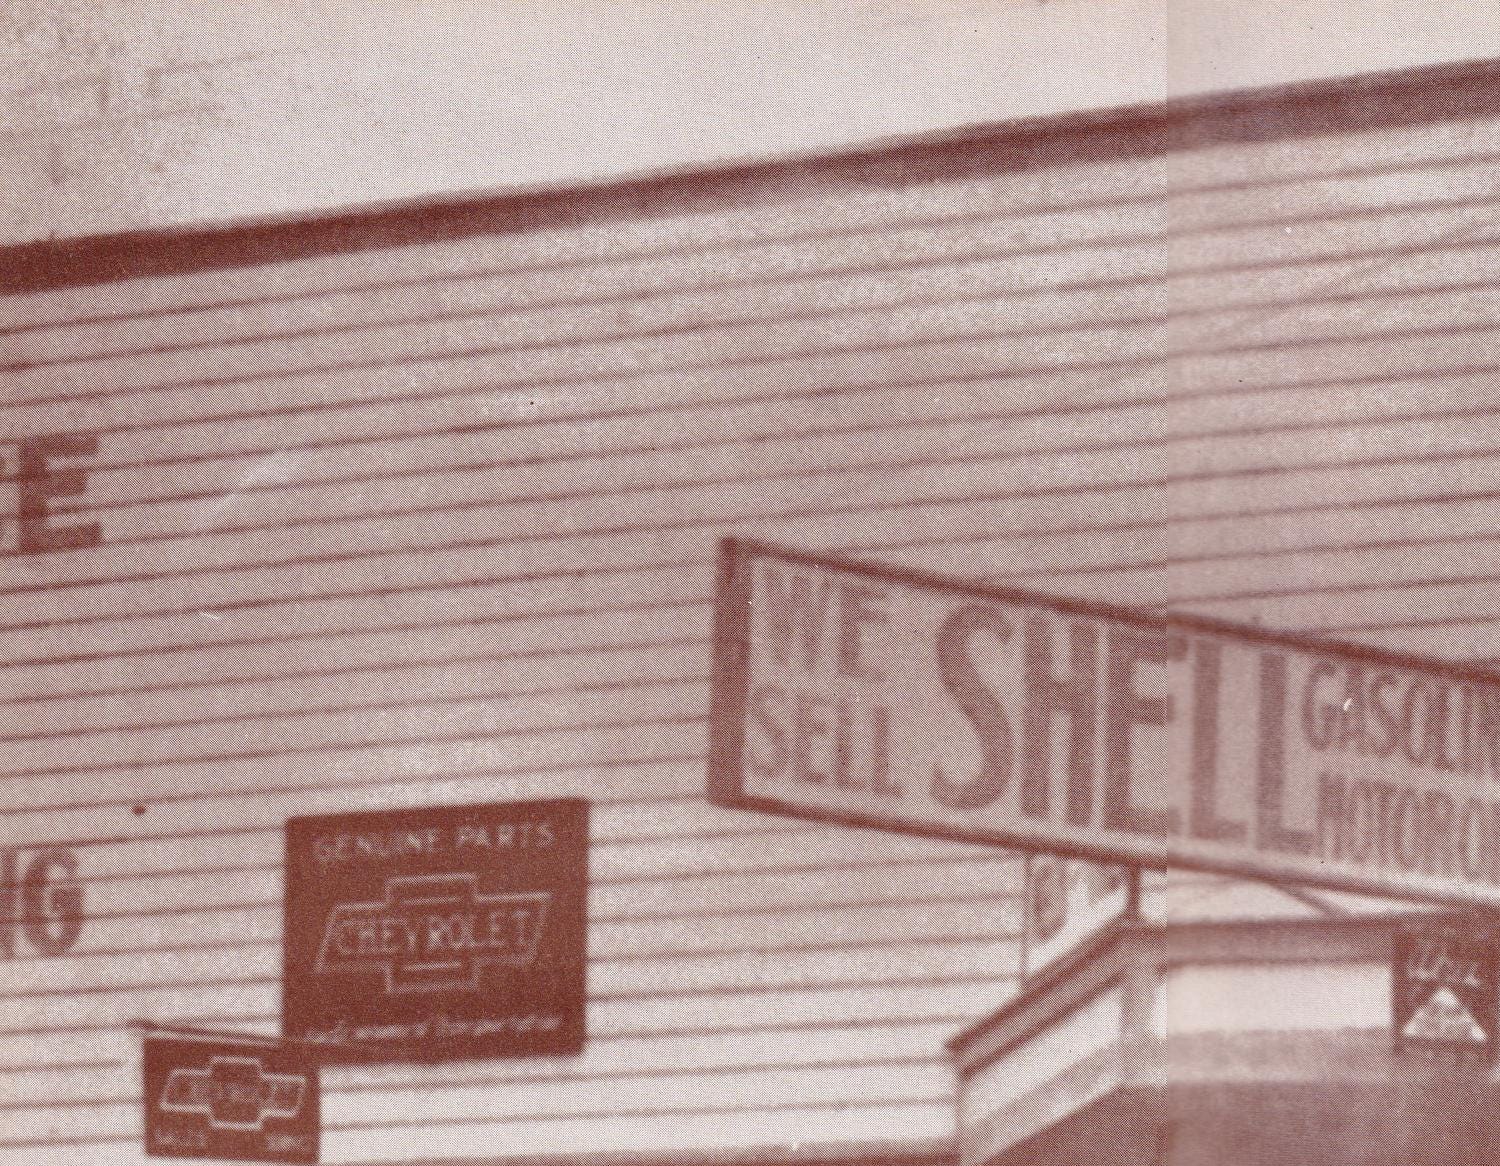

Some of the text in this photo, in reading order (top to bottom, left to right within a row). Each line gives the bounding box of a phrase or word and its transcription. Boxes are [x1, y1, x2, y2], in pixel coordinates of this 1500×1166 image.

[762, 562, 890, 684] WE
[748, 684, 906, 799] SELL
[929, 604, 1315, 858] SHELL
[312, 819, 556, 864] GENUINE PARTS
[334, 907, 532, 957] CHEVROLET
